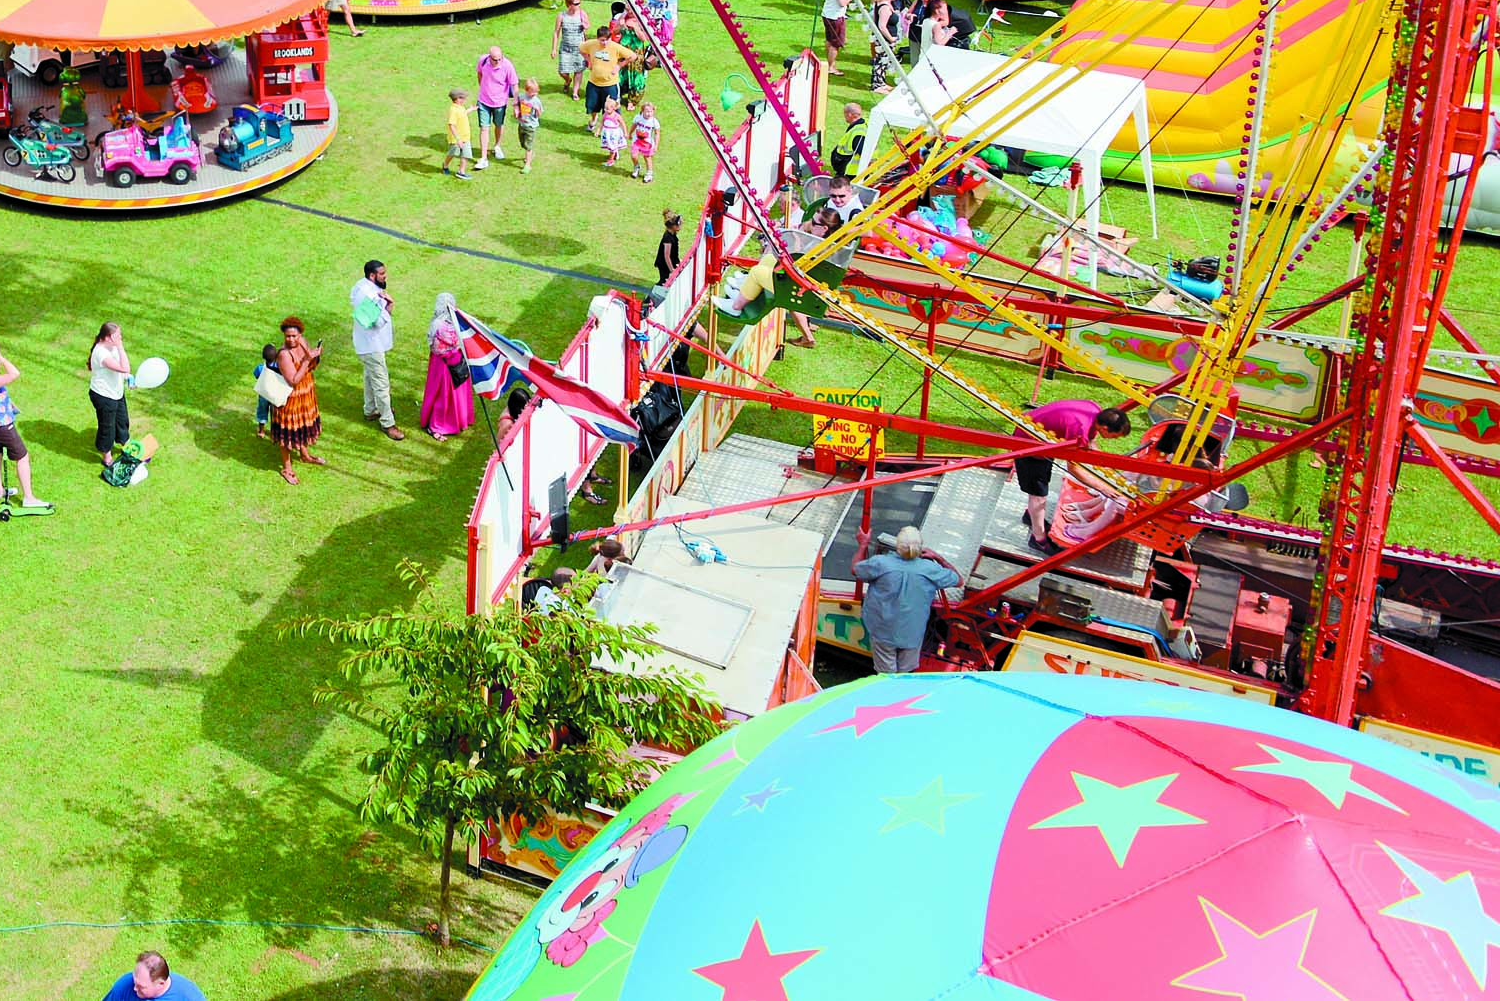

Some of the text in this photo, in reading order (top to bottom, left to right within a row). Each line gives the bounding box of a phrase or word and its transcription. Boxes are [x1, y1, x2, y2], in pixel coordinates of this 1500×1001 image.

[274, 46, 313, 58] BROOKLANDS
[814, 392, 882, 407] CAUTION
[817, 421, 850, 432] SWING
[841, 434, 856, 444] NO
